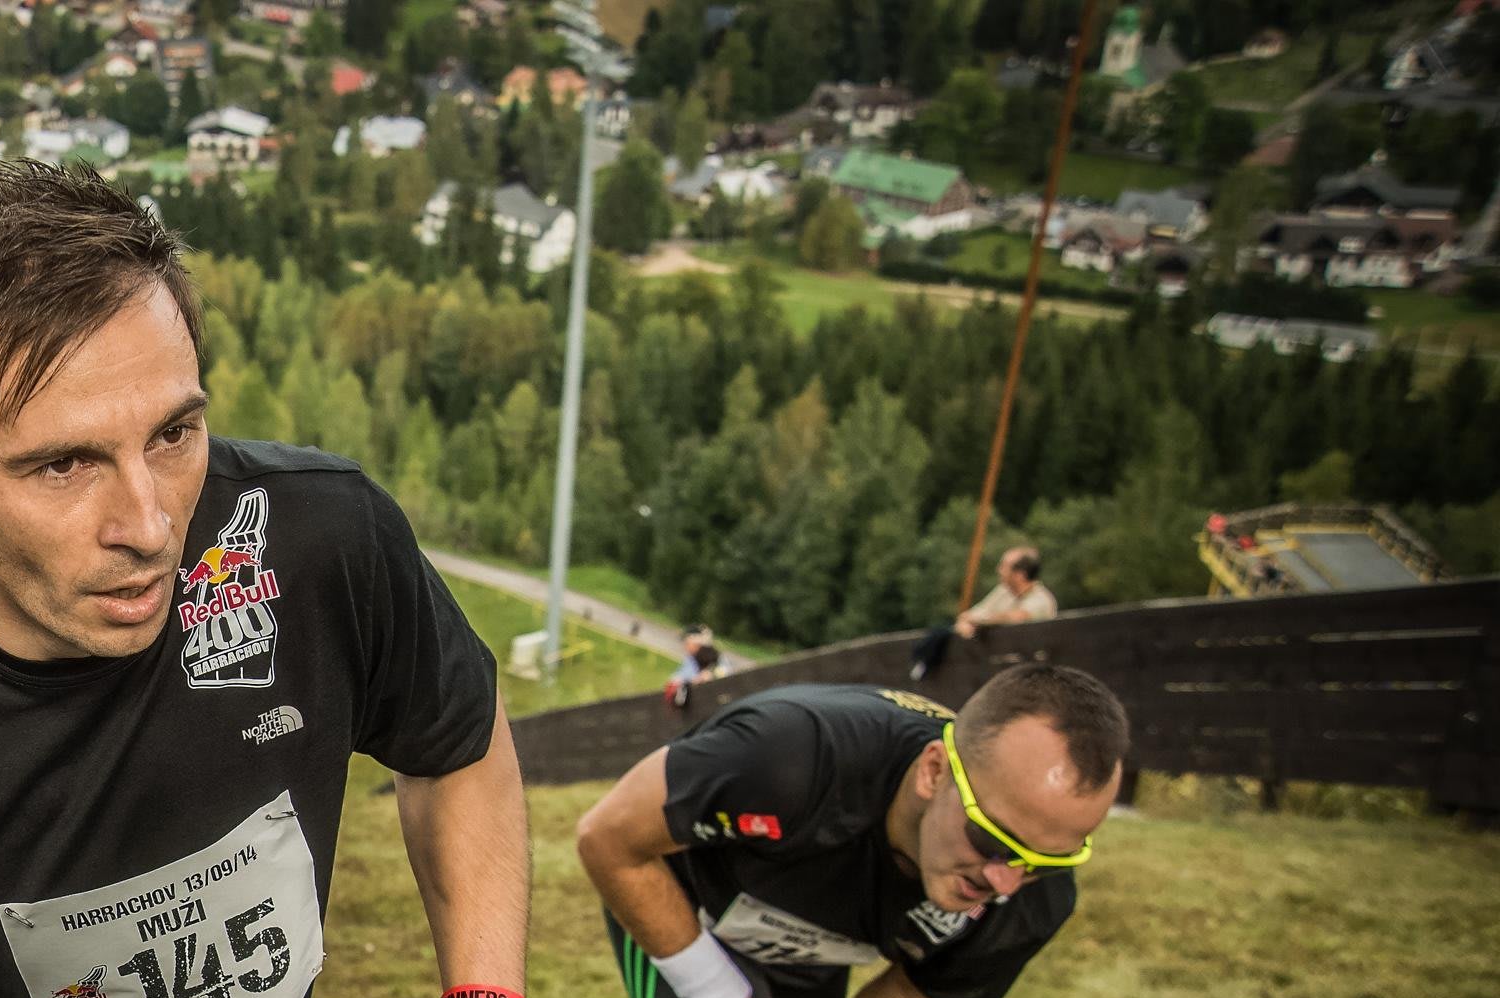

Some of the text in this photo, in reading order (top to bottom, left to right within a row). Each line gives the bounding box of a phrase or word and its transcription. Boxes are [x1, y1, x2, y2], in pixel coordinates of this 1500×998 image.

[179, 571, 279, 631] Red Bull
[185, 602, 275, 658] 400
[192, 640, 270, 677] HARRACHOV
[241, 717, 282, 741] NORTH
[255, 726, 284, 745] FACE
[257, 707, 280, 724] THE
[60, 844, 259, 932] HARRACHOV 13/09/14
[136, 896, 207, 943] MUŽI
